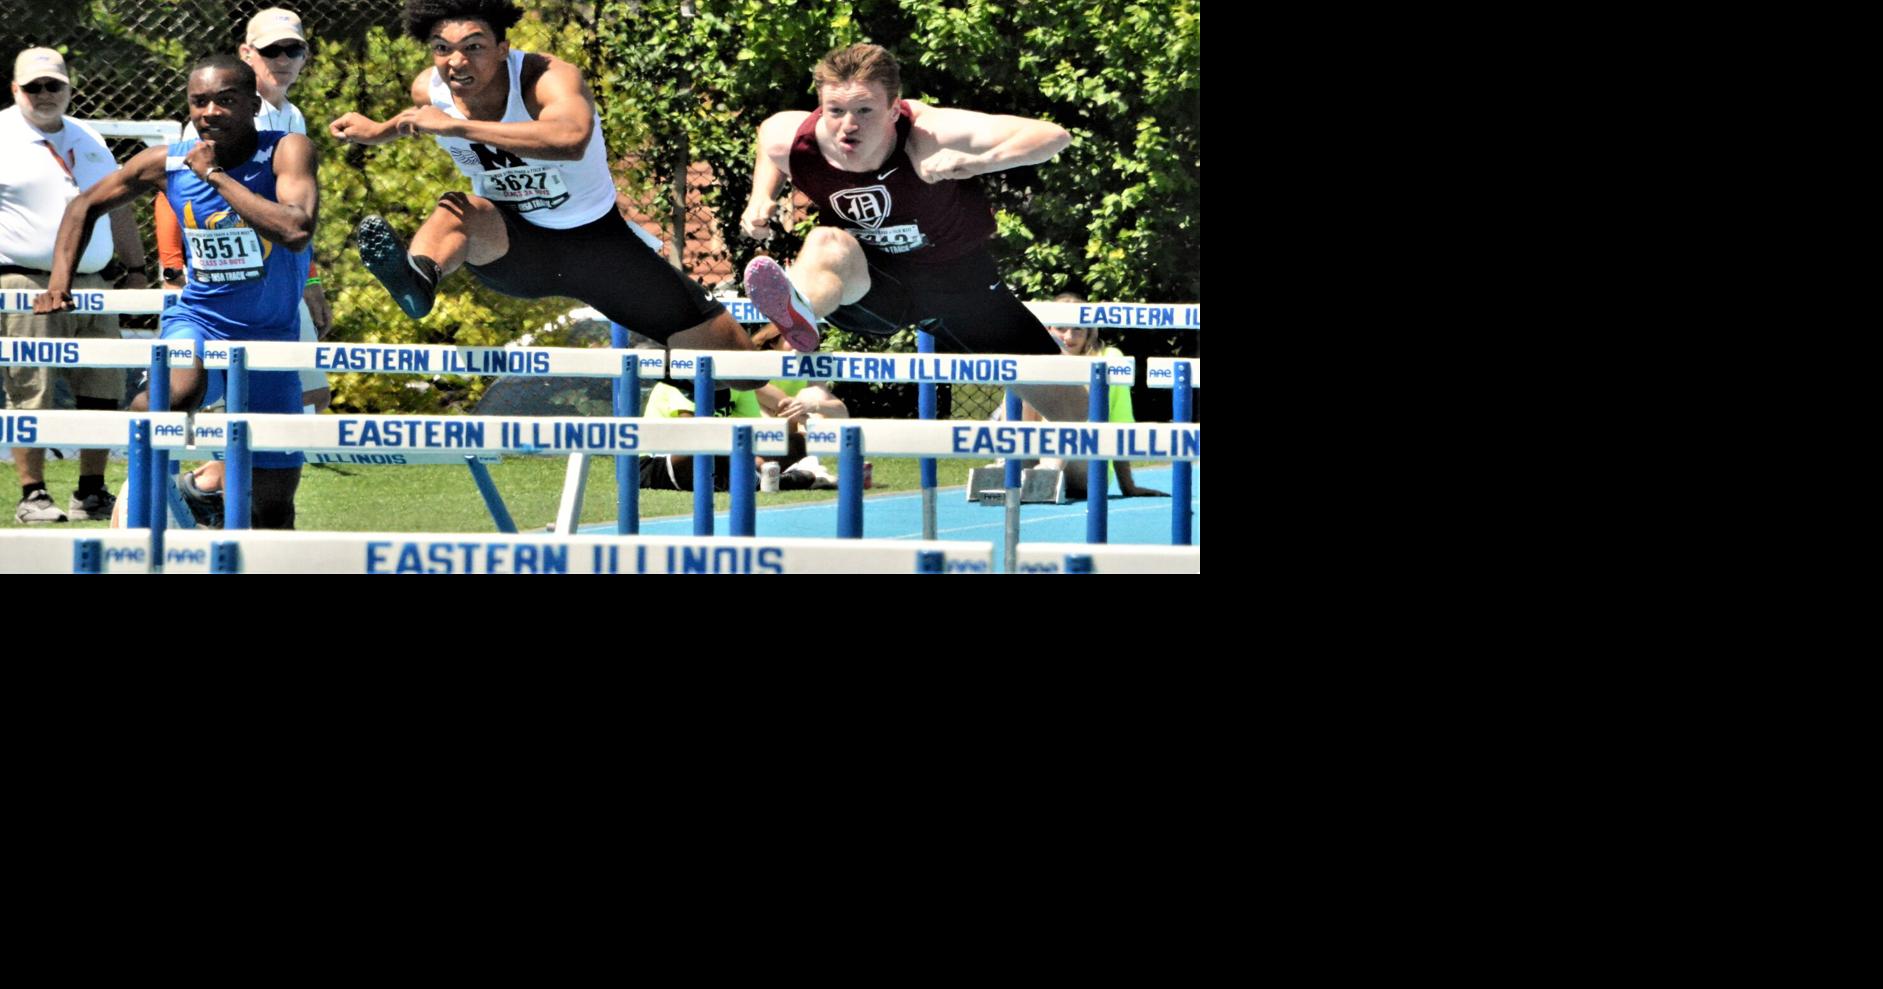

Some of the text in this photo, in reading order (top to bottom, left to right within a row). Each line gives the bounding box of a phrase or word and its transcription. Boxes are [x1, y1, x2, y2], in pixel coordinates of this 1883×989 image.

[490, 172, 546, 191] 3627
[192, 236, 249, 259] 3551
[1080, 307, 1174, 326] EASTERN
[315, 347, 549, 373] EASTERN ILLINOIS
[781, 356, 1017, 381] EASTERN ILLINOIS
[339, 420, 639, 450] EASTERN ILLINOIS
[953, 427, 1200, 456] EASTERN ILLIN
[316, 454, 407, 464] ILLINOIS
[366, 542, 568, 574] EASTERN
